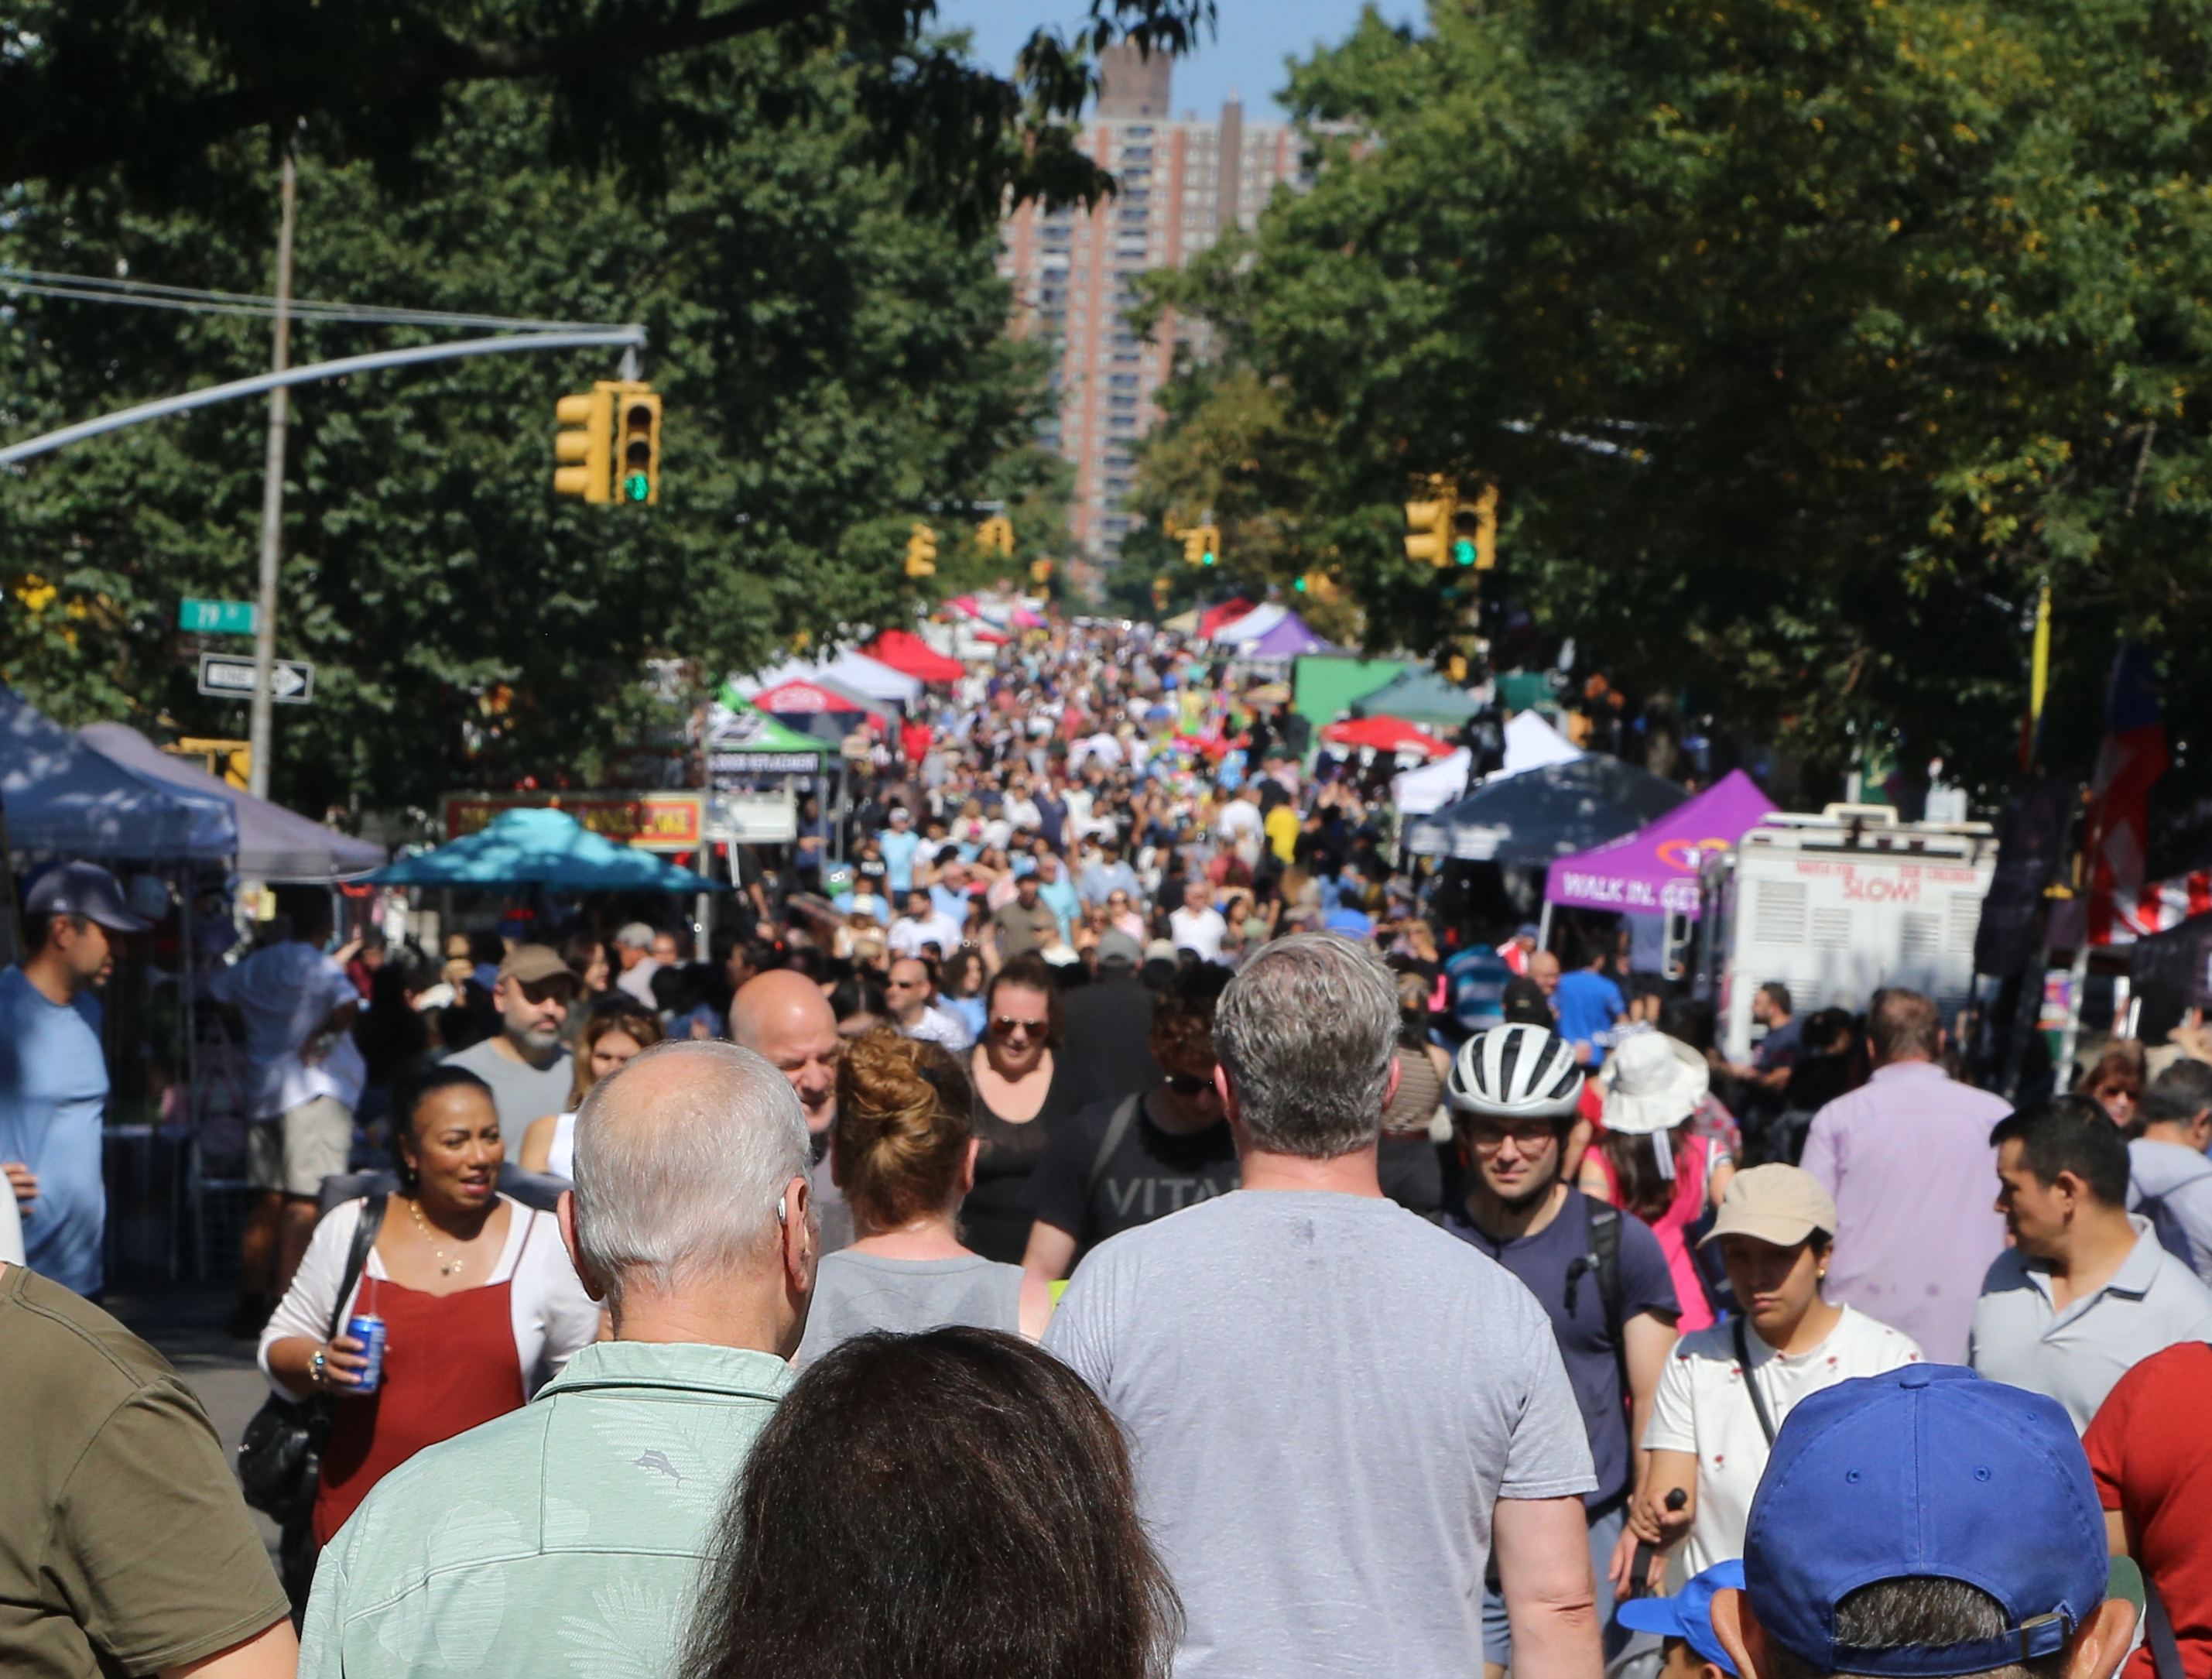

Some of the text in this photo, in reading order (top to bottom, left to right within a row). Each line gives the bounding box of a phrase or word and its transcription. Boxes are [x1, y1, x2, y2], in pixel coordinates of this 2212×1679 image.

[1563, 872, 1625, 903] WALK
[1626, 880, 1656, 906] IN.
[1843, 872, 1922, 903] SLOW!
[1107, 1177, 1241, 1217] VITA
